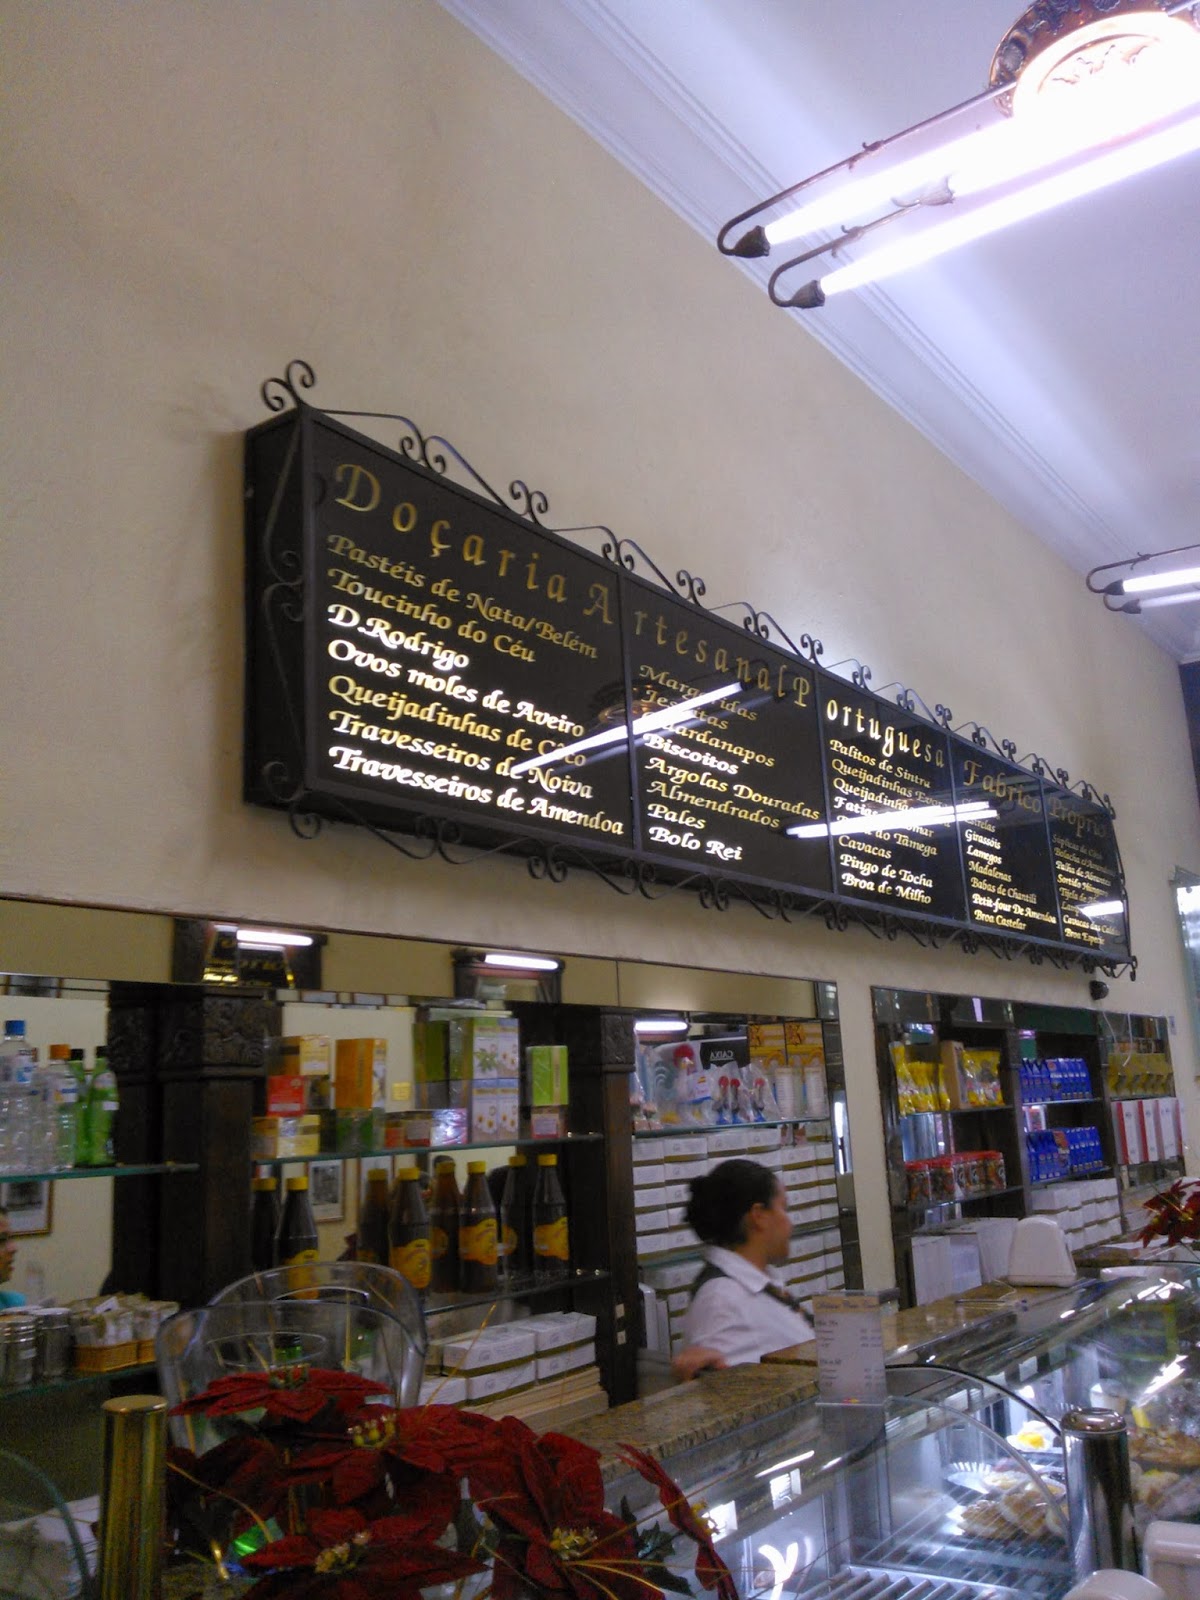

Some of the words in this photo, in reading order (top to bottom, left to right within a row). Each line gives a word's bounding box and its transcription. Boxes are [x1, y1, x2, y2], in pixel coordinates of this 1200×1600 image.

[328, 534, 425, 587] Pastéis
[431, 579, 461, 602] de
[466, 593, 597, 659] Nata/Belém
[328, 568, 452, 630] Toucinho
[458, 620, 488, 643] do
[493, 635, 536, 663] Céu
[328, 603, 470, 671] D.Rodrigo
[335, 464, 567, 603] Doçaria
[963, 760, 1042, 813] Fabrico
[328, 639, 402, 678] Ovos
[407, 666, 479, 703] moles
[482, 689, 511, 713] de
[512, 700, 585, 737] Aveiro
[639, 664, 758, 721] Margidas
[641, 689, 729, 730] Jesitas
[328, 675, 502, 743] Queijadinhas
[506, 728, 533, 751] de
[537, 739, 586, 767] Cco
[642, 711, 775, 767] ardanapos
[328, 710, 491, 771] Travesseiros
[528, 766, 593, 799] Noiva
[643, 732, 739, 775] Biscoitos
[829, 739, 876, 766] Palitos
[878, 760, 894, 773] de
[894, 766, 931, 789] Sintra
[328, 746, 493, 803] Travesseiros
[497, 787, 525, 813] de
[526, 796, 624, 836] Amendoa
[645, 757, 729, 793] Argolas
[733, 784, 820, 820] Douradas
[831, 758, 913, 798] Queijadinhas
[646, 780, 780, 828] Almendrados
[647, 803, 707, 830] Pales
[648, 826, 701, 850] Bolo
[705, 840, 743, 861] Rei
[838, 835, 892, 859] Cavacas
[966, 845, 1002, 866] Lamegos
[840, 853, 879, 876] Pingo
[881, 864, 897, 878] de
[899, 869, 933, 888] Tocha
[841, 872, 875, 892] Broa
[878, 881, 893, 895] de
[895, 885, 932, 904] Milho
[968, 860, 1012, 882] Madalenas
[997, 884, 1006, 896] de
[974, 909, 995, 924] Broa
